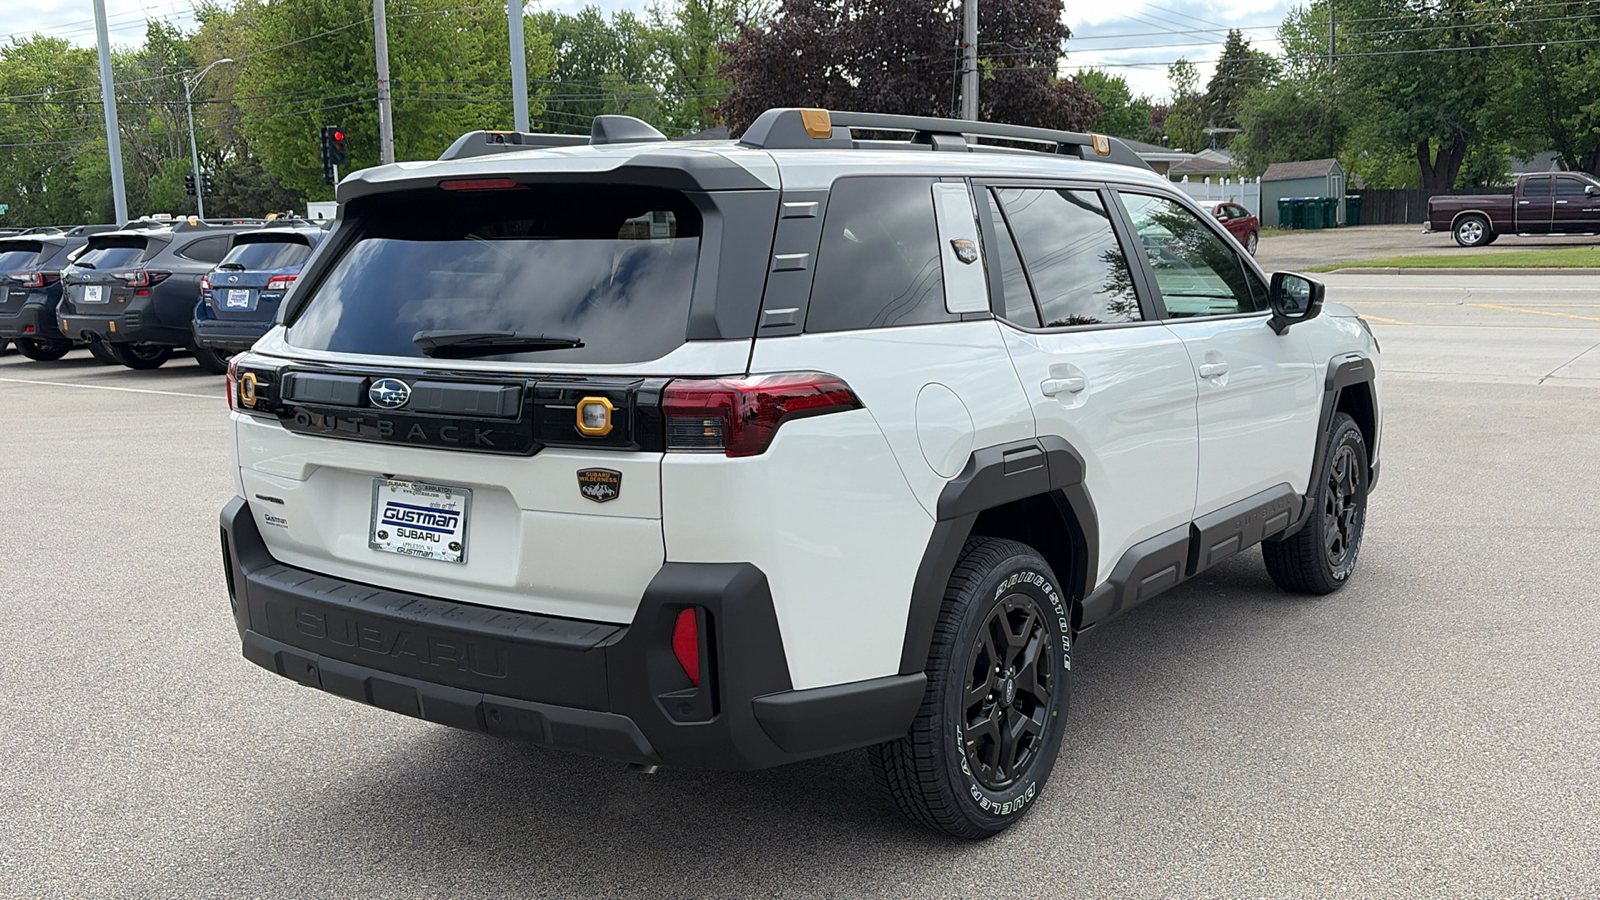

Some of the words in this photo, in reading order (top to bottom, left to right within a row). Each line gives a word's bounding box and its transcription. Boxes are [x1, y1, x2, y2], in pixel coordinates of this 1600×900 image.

[294, 411, 494, 446] OUTBACK
[424, 485, 453, 494] APPLETON
[396, 527, 441, 543] SUBARU
[993, 571, 1071, 671] BRIDGESTONE
[295, 607, 508, 679] SUBARU
[956, 724, 971, 776] A/T
[970, 781, 1036, 815] DUELER
